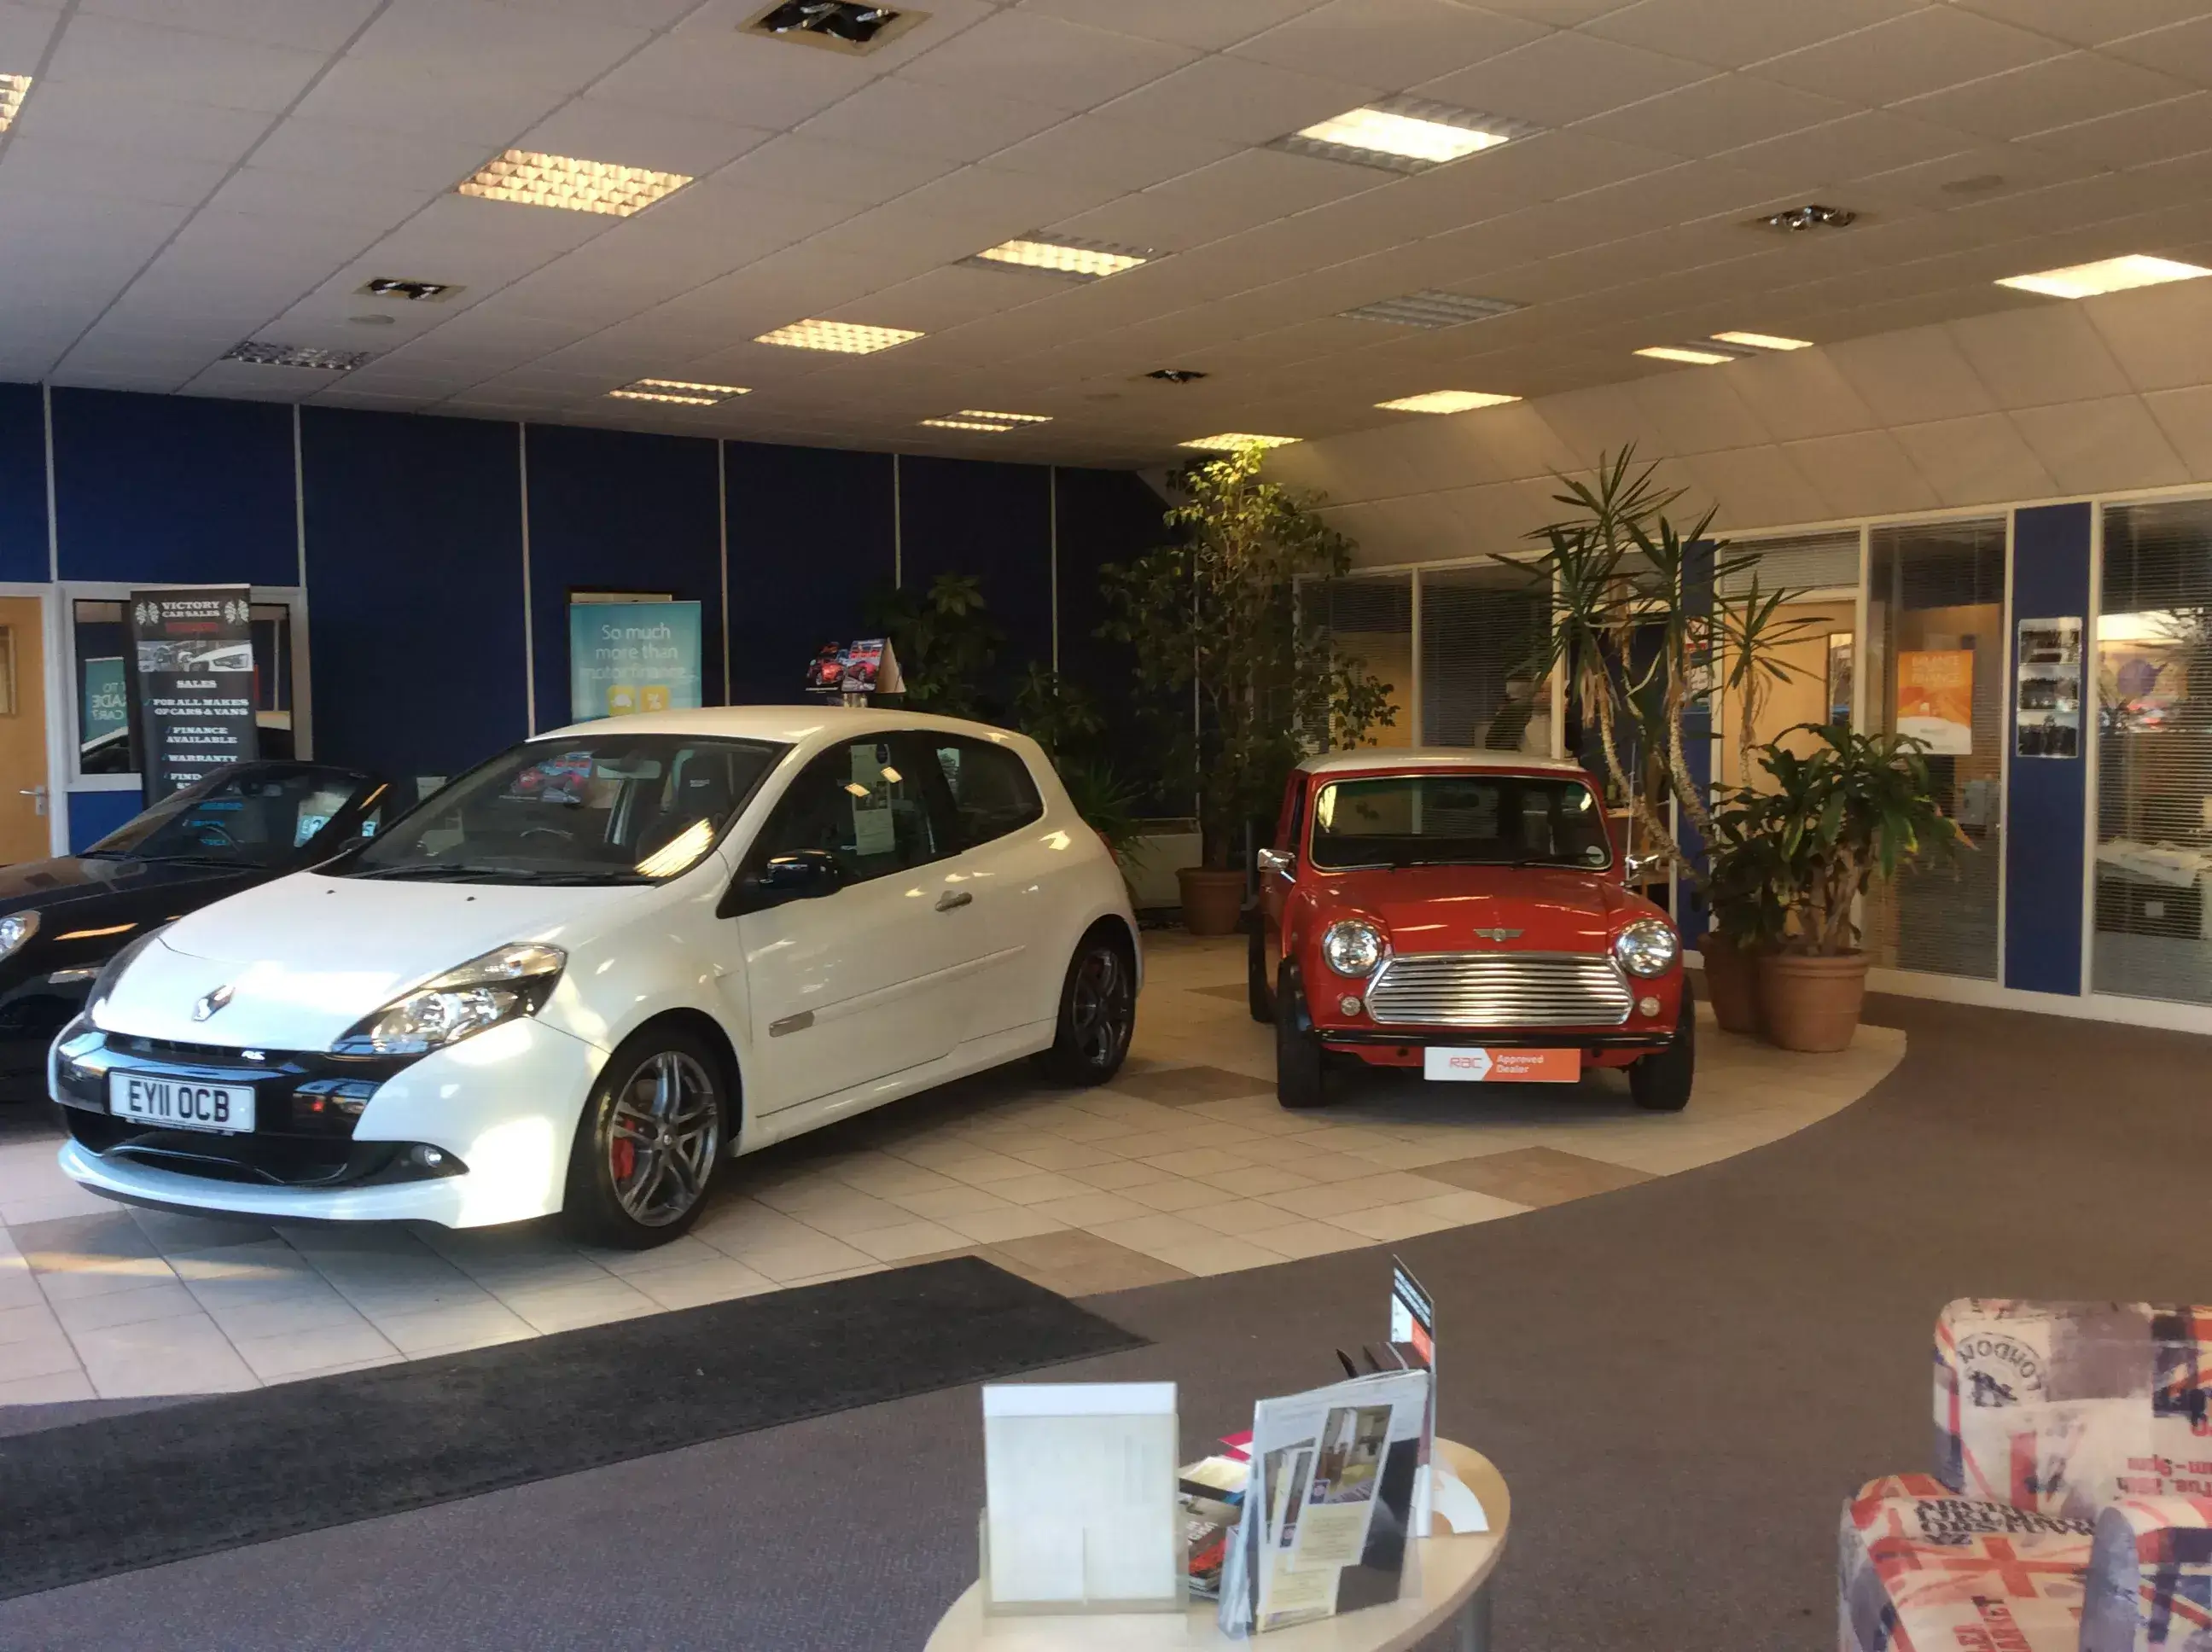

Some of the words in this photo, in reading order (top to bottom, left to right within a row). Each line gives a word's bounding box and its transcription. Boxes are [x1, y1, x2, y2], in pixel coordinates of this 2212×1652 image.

[161, 601, 220, 610] VICTORY
[601, 624, 621, 640] So
[626, 622, 671, 640] much
[595, 646, 639, 660] more
[642, 642, 678, 660] than
[176, 680, 217, 689] SALES
[172, 726, 229, 735] FINANCE
[166, 736, 238, 744] AVAILABLE
[1496, 1054, 1545, 1066] Approved
[1496, 1064, 1529, 1073] Dealer
[129, 1079, 171, 1117] EY11
[178, 1086, 230, 1123] OCB
